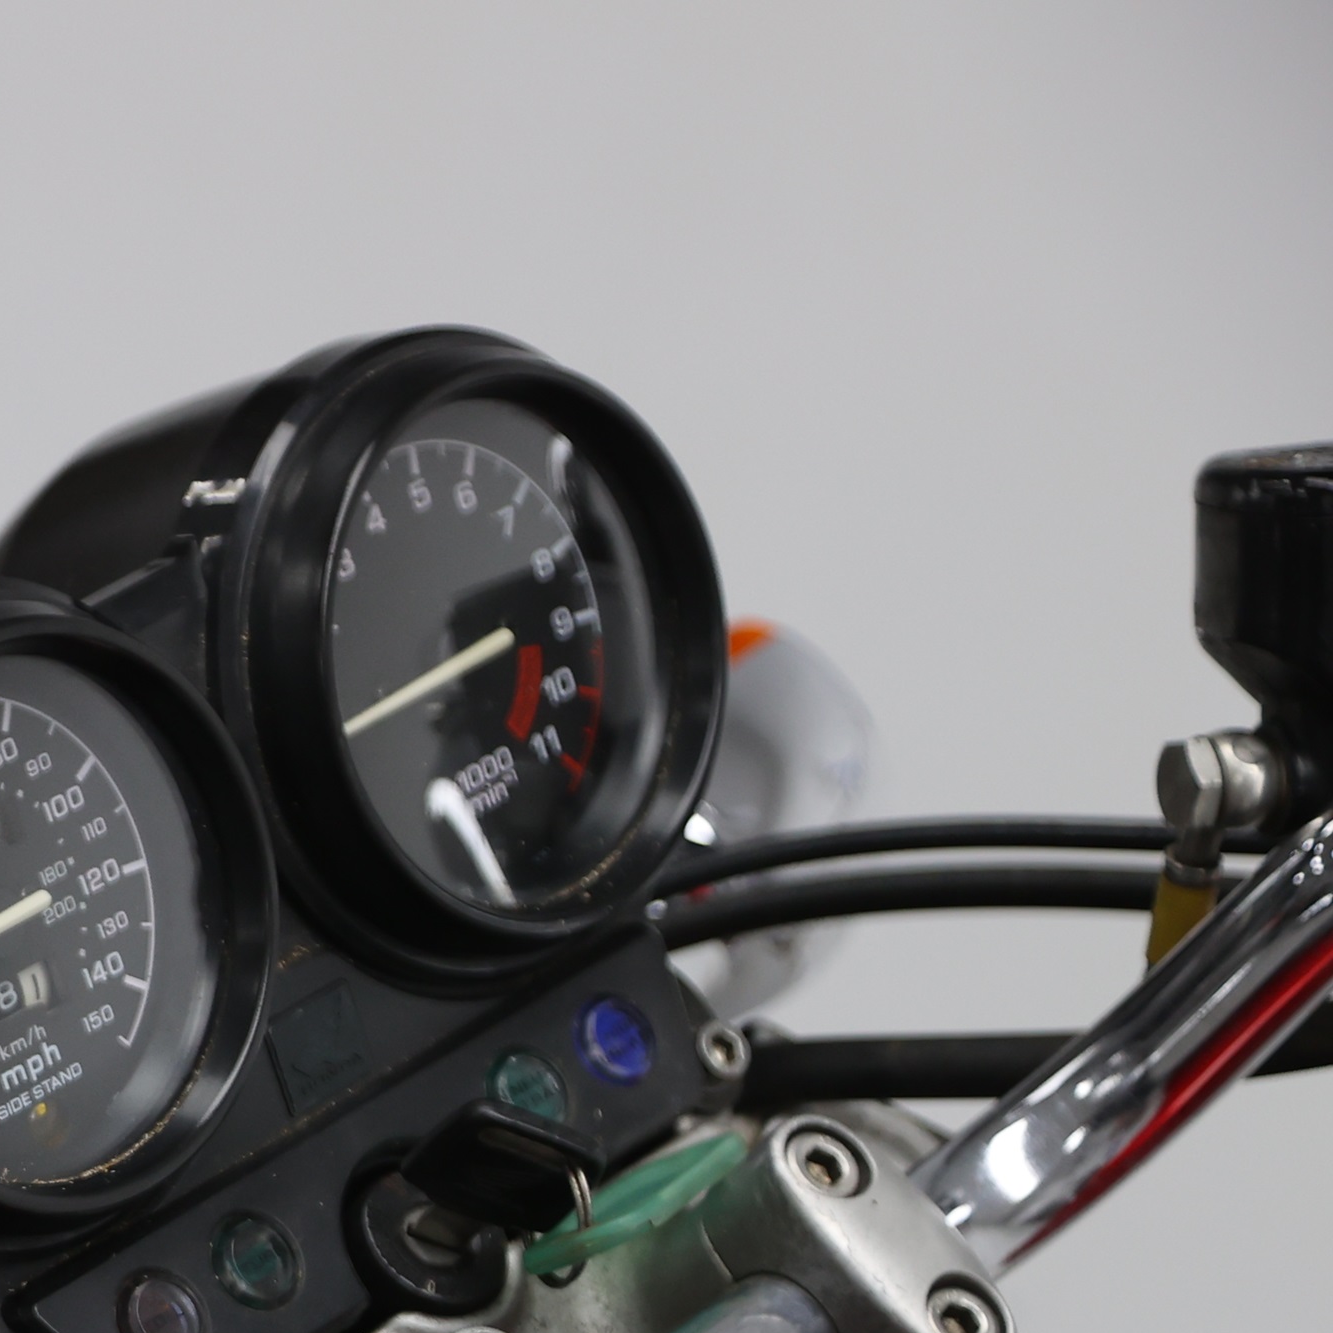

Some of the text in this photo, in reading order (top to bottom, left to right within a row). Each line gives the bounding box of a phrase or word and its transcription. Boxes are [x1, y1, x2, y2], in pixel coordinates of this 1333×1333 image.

[407, 479, 433, 514] 5
[452, 479, 478, 515] 6
[365, 502, 387, 535] 4
[494, 502, 515, 540] 7
[530, 547, 556, 584] 8
[548, 605, 574, 643] 9
[539, 666, 577, 707] 10
[529, 724, 563, 765] 11
[25, 752, 52, 777] 90
[453, 745, 514, 794] 1000
[42, 785, 85, 822] 100
[82, 816, 108, 841] 110
[39, 860, 67, 886] 180
[78, 858, 120, 896] 120
[42, 895, 76, 925] 200
[97, 910, 129, 939] 130
[82, 951, 124, 989] 140
[82, 1004, 115, 1033] 150
[0, 1042, 62, 1090] mph
[33, 1061, 83, 1099] STAND
